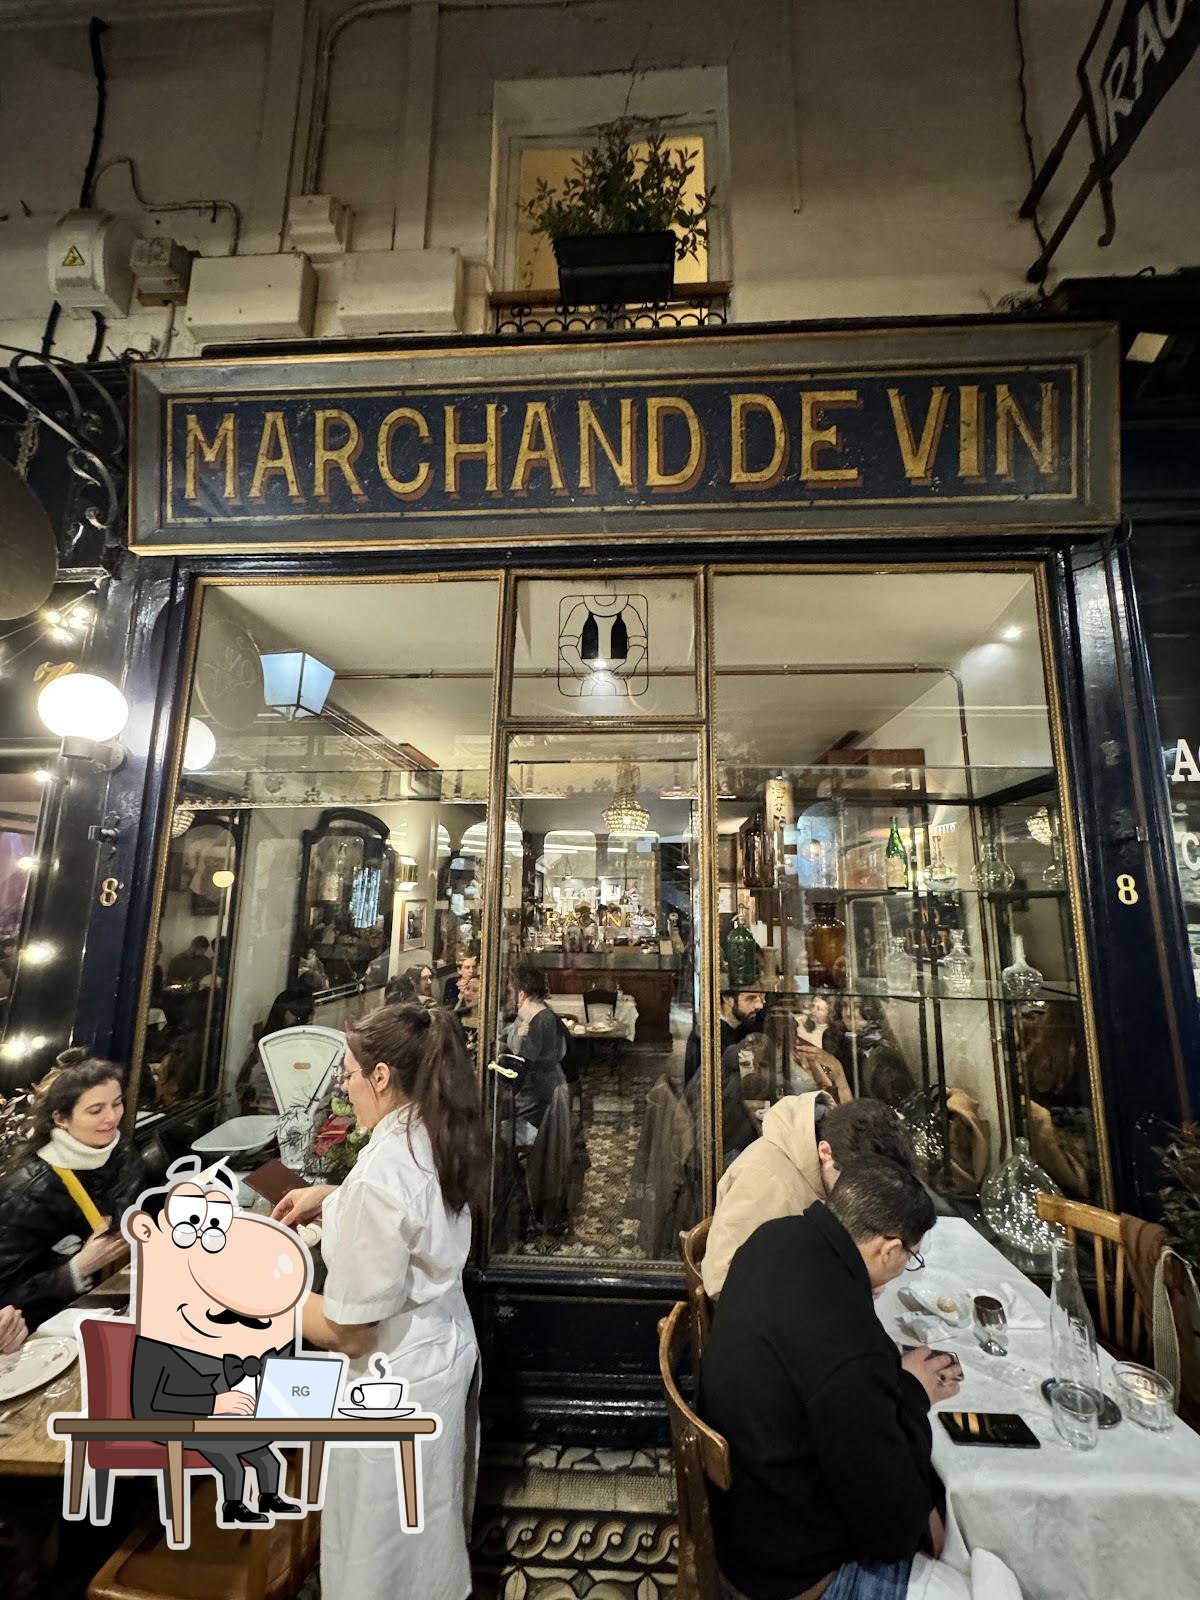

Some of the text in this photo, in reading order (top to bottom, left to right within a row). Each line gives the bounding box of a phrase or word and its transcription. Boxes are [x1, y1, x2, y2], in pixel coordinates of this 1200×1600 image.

[184, 382, 1061, 505] MARCHAND DE VIN
[100, 877, 118, 907] 8
[1116, 873, 1139, 905] 8
